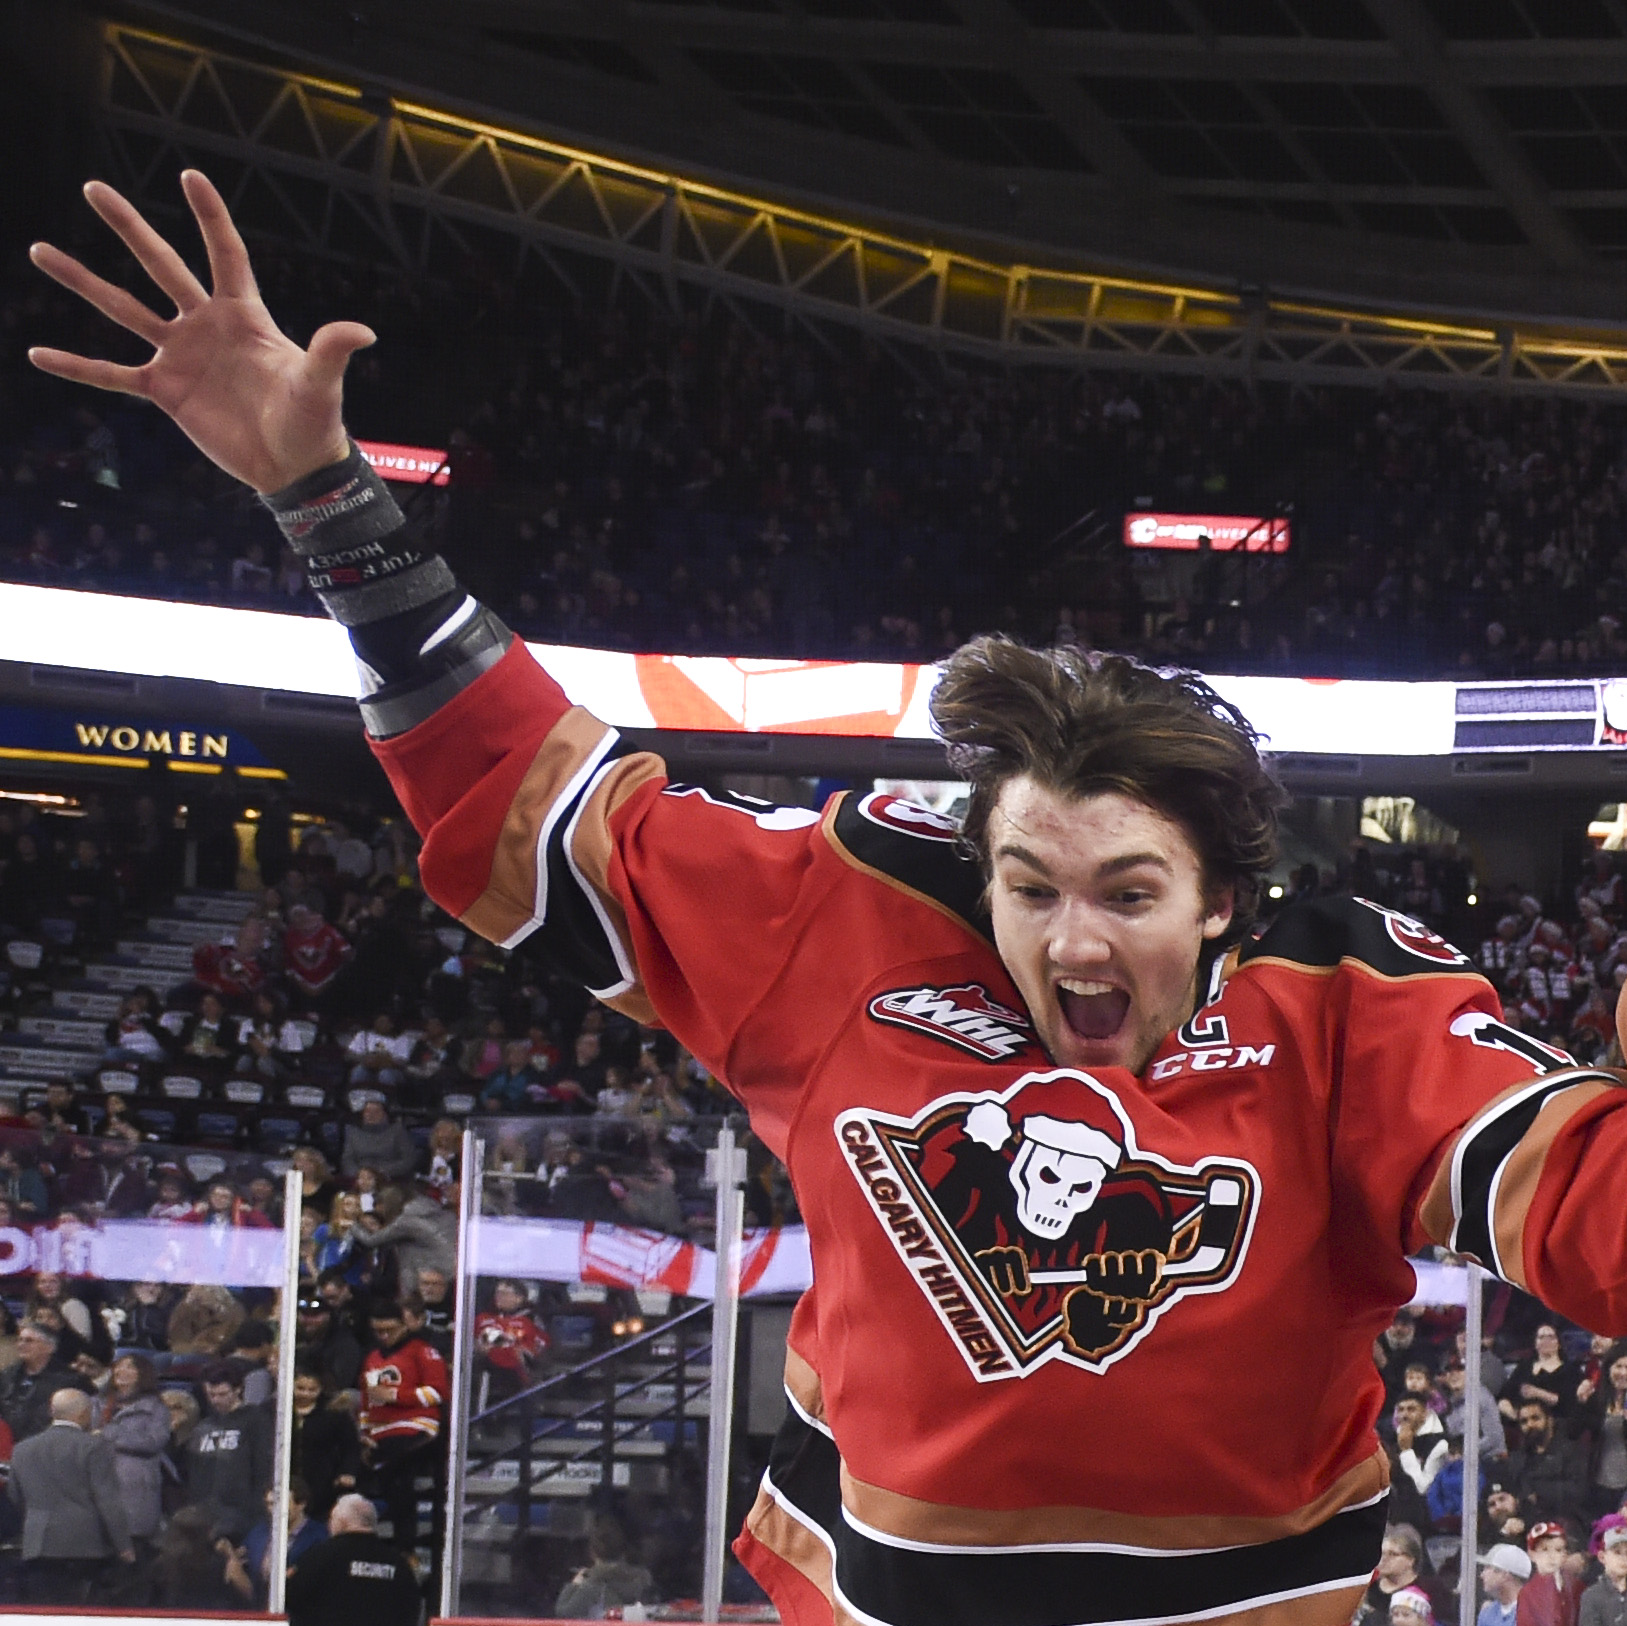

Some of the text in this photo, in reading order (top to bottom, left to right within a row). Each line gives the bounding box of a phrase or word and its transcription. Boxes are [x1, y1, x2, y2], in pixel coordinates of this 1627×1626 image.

[369, 455, 417, 471] LIVES
[75, 722, 228, 758] WOMEN
[902, 988, 1031, 1060] WHL
[1151, 1043, 1277, 1081] CCM
[838, 1117, 1014, 1378] CALGARY HITMEN
[350, 1560, 397, 1580] SECURITY
